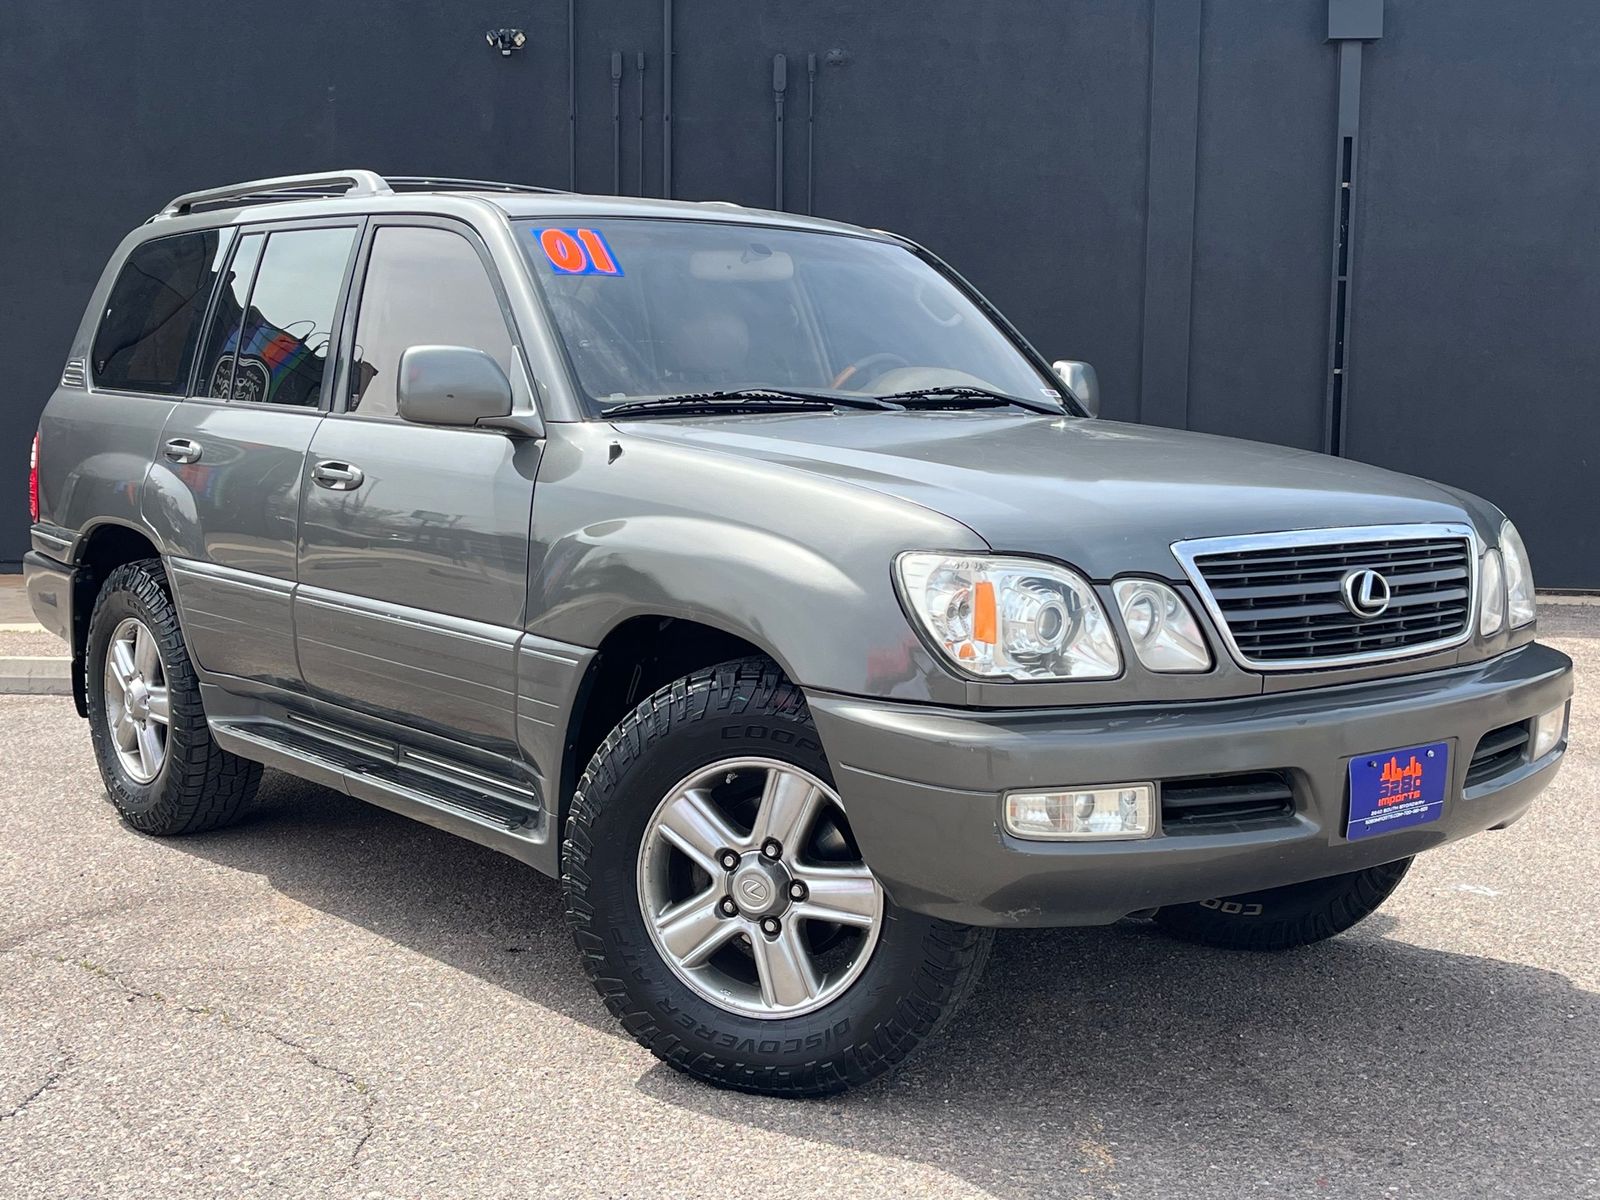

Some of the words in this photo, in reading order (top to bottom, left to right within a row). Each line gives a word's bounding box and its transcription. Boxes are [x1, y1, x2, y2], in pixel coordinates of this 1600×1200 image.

[541, 229, 617, 273] 01
[721, 724, 821, 753] COOP
[656, 998, 850, 1055] DISCOVERER
